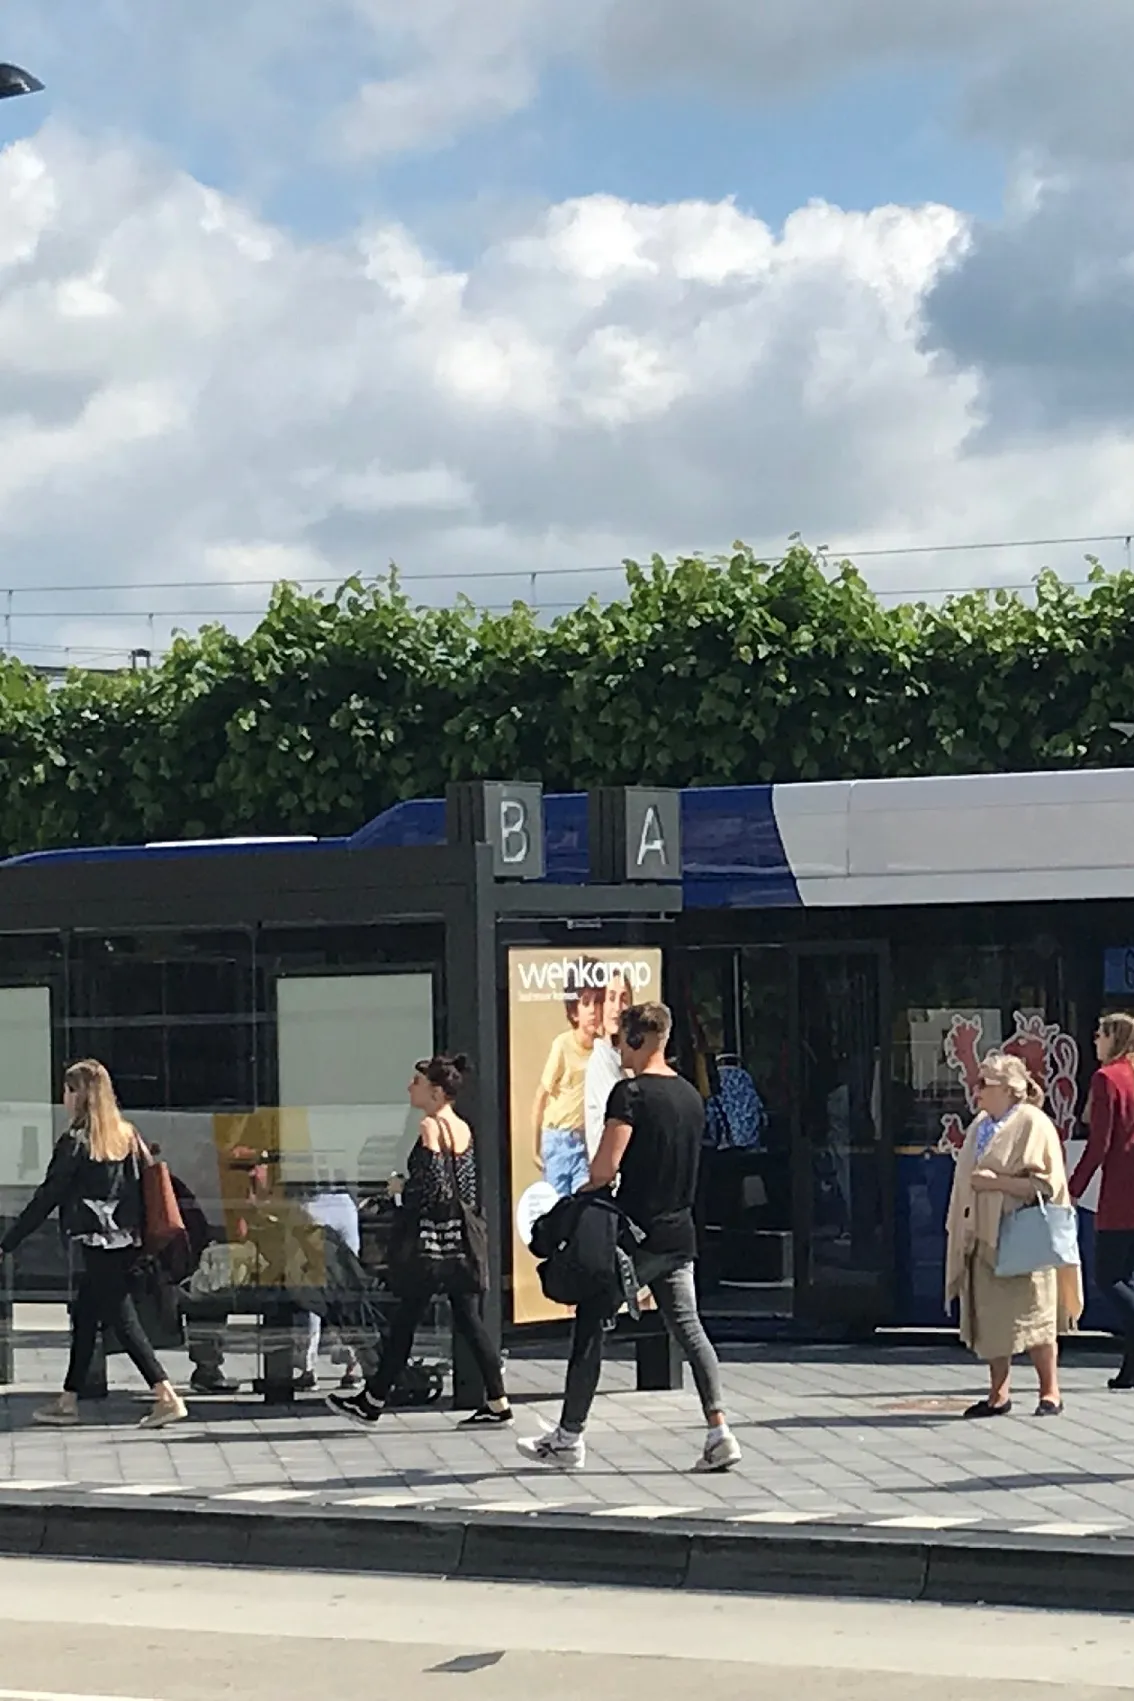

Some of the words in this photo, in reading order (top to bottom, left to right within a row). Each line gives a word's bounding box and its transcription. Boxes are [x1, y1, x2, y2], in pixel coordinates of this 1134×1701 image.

[500, 800, 528, 863] B
[636, 804, 668, 865] A
[518, 956, 652, 993] wehkamp
